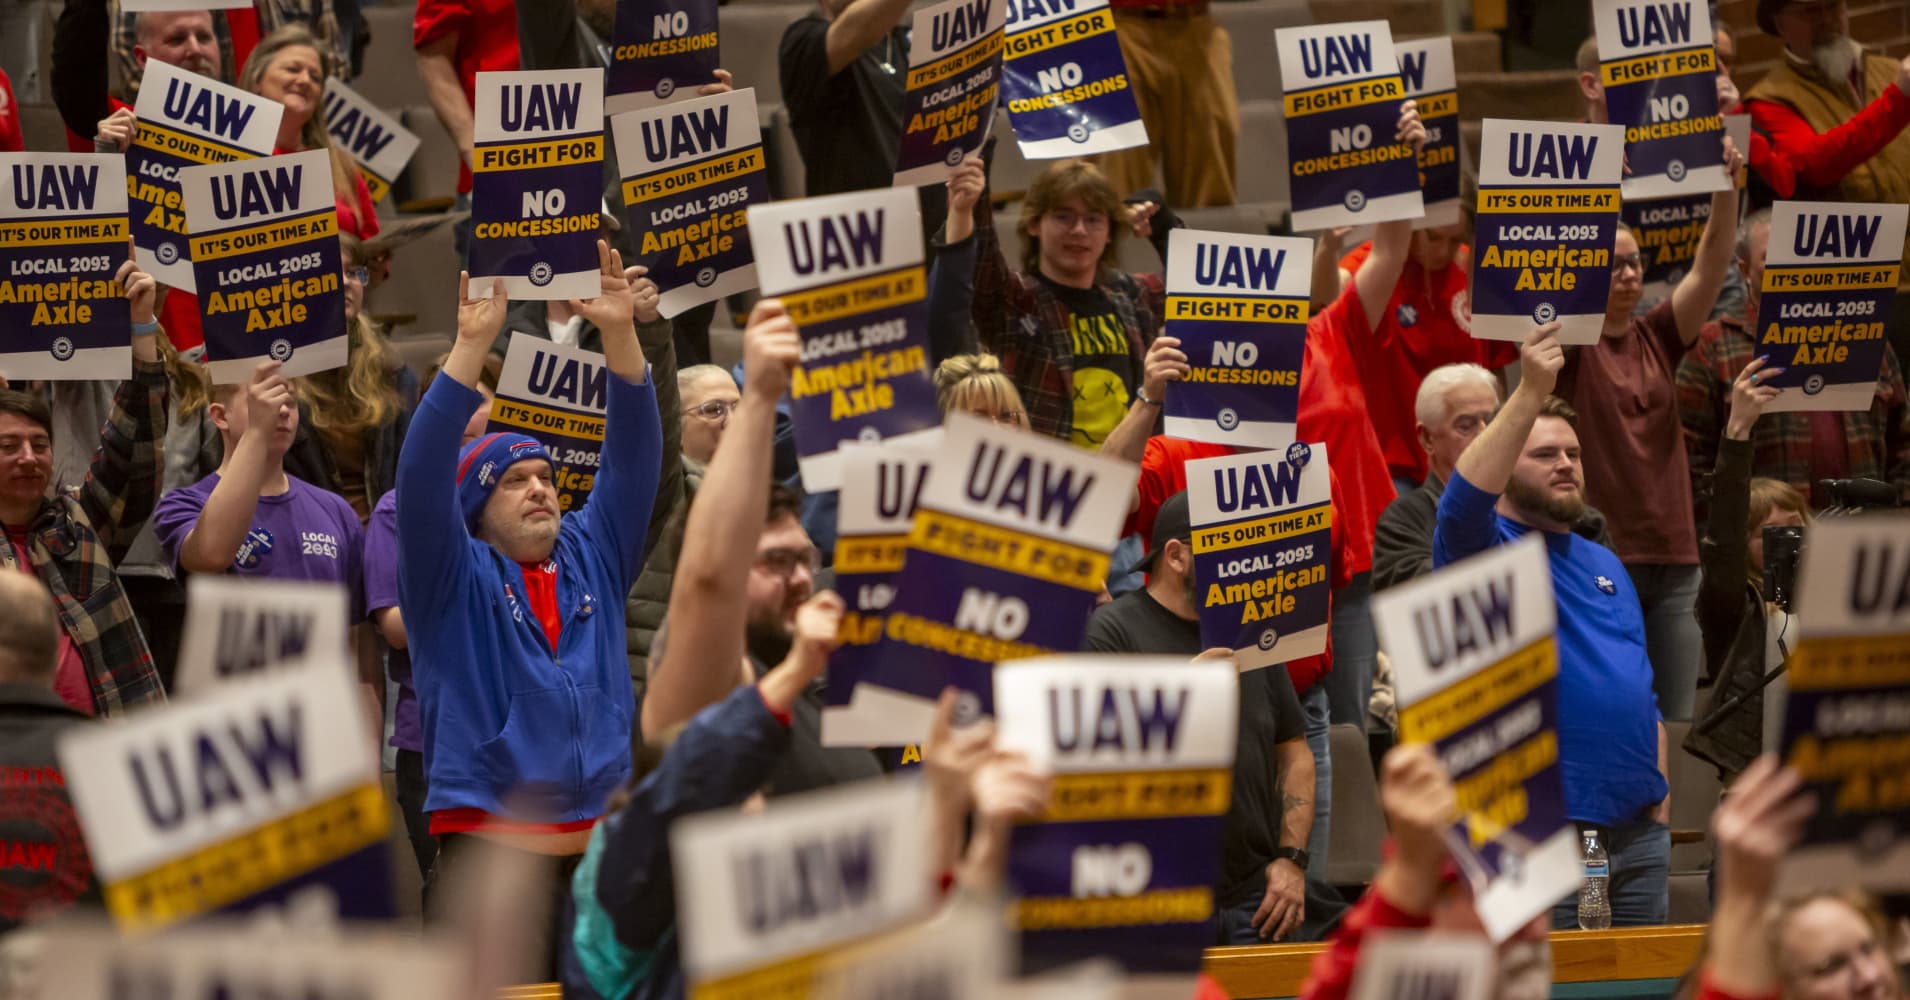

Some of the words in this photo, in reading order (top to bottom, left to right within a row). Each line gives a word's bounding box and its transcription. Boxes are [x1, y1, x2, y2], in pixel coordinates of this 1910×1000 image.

[653, 11, 689, 40] NO
[932, 0, 991, 52] UAW
[1005, 28, 1055, 56] IGHT
[1061, 15, 1105, 39] FOR
[1617, 2, 1691, 48] UAW
[615, 32, 718, 61] CONCESSIONS
[914, 68, 937, 84] IT'S
[940, 58, 962, 76] OUR
[966, 47, 987, 64] TIME
[988, 36, 1000, 52] AT
[1300, 33, 1372, 78] UAW
[1037, 62, 1083, 93] NO
[1610, 58, 1671, 82] FIGHT
[1676, 54, 1710, 70] FOR
[922, 82, 964, 108] LOCAL
[966, 66, 993, 91] 2093
[1008, 74, 1128, 113] CONCESSIONS
[1293, 88, 1353, 112] FIGHT
[1360, 82, 1397, 100] FOR
[164, 77, 255, 141] UAW
[501, 83, 582, 132] UAW
[906, 82, 998, 135] American
[1650, 94, 1690, 123] NO
[136, 128, 165, 146] IT'S
[168, 138, 200, 156] OUR
[203, 147, 238, 162] TIME
[641, 105, 729, 163] UAW
[932, 114, 978, 145] Axle
[1330, 124, 1373, 153] NO
[1625, 115, 1721, 144] ONCESSION
[139, 160, 181, 182] LOC
[483, 147, 551, 167] FIGHT
[557, 142, 596, 161] FOR
[1293, 143, 1412, 176] CONCESSIONS
[1508, 132, 1598, 179] UAW
[12, 165, 99, 210] UAW
[210, 165, 302, 220] UAW
[633, 181, 662, 198] IT'S
[664, 172, 697, 190] OUR
[699, 162, 735, 181] TIME
[737, 155, 756, 170] AT
[522, 188, 566, 218] NO
[651, 200, 705, 226] LOCAL
[708, 186, 748, 208] 2093
[1487, 195, 1516, 208] IT'S
[1520, 195, 1553, 207] OUR
[1556, 195, 1592, 207] TIME
[1593, 194, 1612, 206] AT
[1641, 206, 1689, 224] LOCAL
[1692, 203, 1711, 218] 20
[29, 227, 61, 240] OUR
[64, 225, 99, 238] TIME
[102, 224, 120, 237] AT
[144, 206, 189, 235] Ax
[200, 239, 230, 255] IT'S
[233, 233, 267, 249] OUR
[270, 224, 307, 242] TIME
[311, 219, 328, 233] AT
[475, 213, 600, 239] CONCESSIONS
[641, 209, 748, 256] America
[1499, 225, 1555, 241] LOCAL
[1558, 225, 1599, 240] 2093
[1631, 220, 1708, 248] Ameri
[1793, 214, 1882, 258] UAW
[676, 234, 734, 267] Axle
[783, 208, 884, 275] UAW
[1480, 244, 1609, 268] American
[1655, 240, 1700, 265] Axl
[11, 259, 67, 275] LOCAL
[70, 256, 110, 272] 2093
[218, 262, 277, 286] LOCAL
[280, 252, 321, 275] 2093
[1195, 243, 1286, 290] UAW
[1515, 268, 1577, 291] Axle
[1771, 274, 1799, 286] IT'S
[1802, 273, 1833, 286] OUR
[1837, 272, 1871, 284] TIME
[1872, 271, 1892, 282] AT
[0, 276, 124, 303] American
[207, 272, 338, 315] American
[32, 301, 92, 326] Axle
[246, 302, 307, 333] Axle
[1176, 301, 1247, 317] FIGHT
[1252, 303, 1299, 319] FOR
[1780, 303, 1832, 318] LOCAL
[1836, 300, 1876, 317] 2093
[799, 330, 859, 362] LOCAL
[1762, 319, 1885, 345] American
[1211, 340, 1259, 367] NO
[1792, 342, 1849, 366] Axle
[528, 351, 607, 409] UAW
[790, 345, 926, 400] American
[1180, 367, 1298, 386] ONCESSIONS
[831, 382, 894, 422] Axle
[500, 405, 529, 422] IT'S
[533, 413, 566, 430] OUR
[569, 420, 604, 436] TIME
[564, 449, 601, 467] 2093
[1292, 444, 1302, 452] NO
[965, 440, 1096, 528] UAW
[1214, 461, 1301, 513] UAW
[302, 532, 337, 545] LOCAL
[926, 523, 1019, 559] FIGHT
[1201, 532, 1230, 548] IT'S
[1234, 526, 1266, 541] OUR
[1269, 517, 1303, 534] TIME
[1306, 512, 1324, 527] AT
[302, 542, 337, 559] 2093
[1218, 555, 1273, 578] LOCAL
[1275, 544, 1314, 567] 2093
[1205, 563, 1326, 607] American
[955, 586, 1031, 641] NO
[1241, 592, 1296, 624] Axle
[1413, 572, 1515, 673] UAW
[215, 604, 318, 679] UAW
[1046, 684, 1191, 752] UAW
[126, 698, 310, 836] UAW
[1070, 842, 1152, 898] NO
